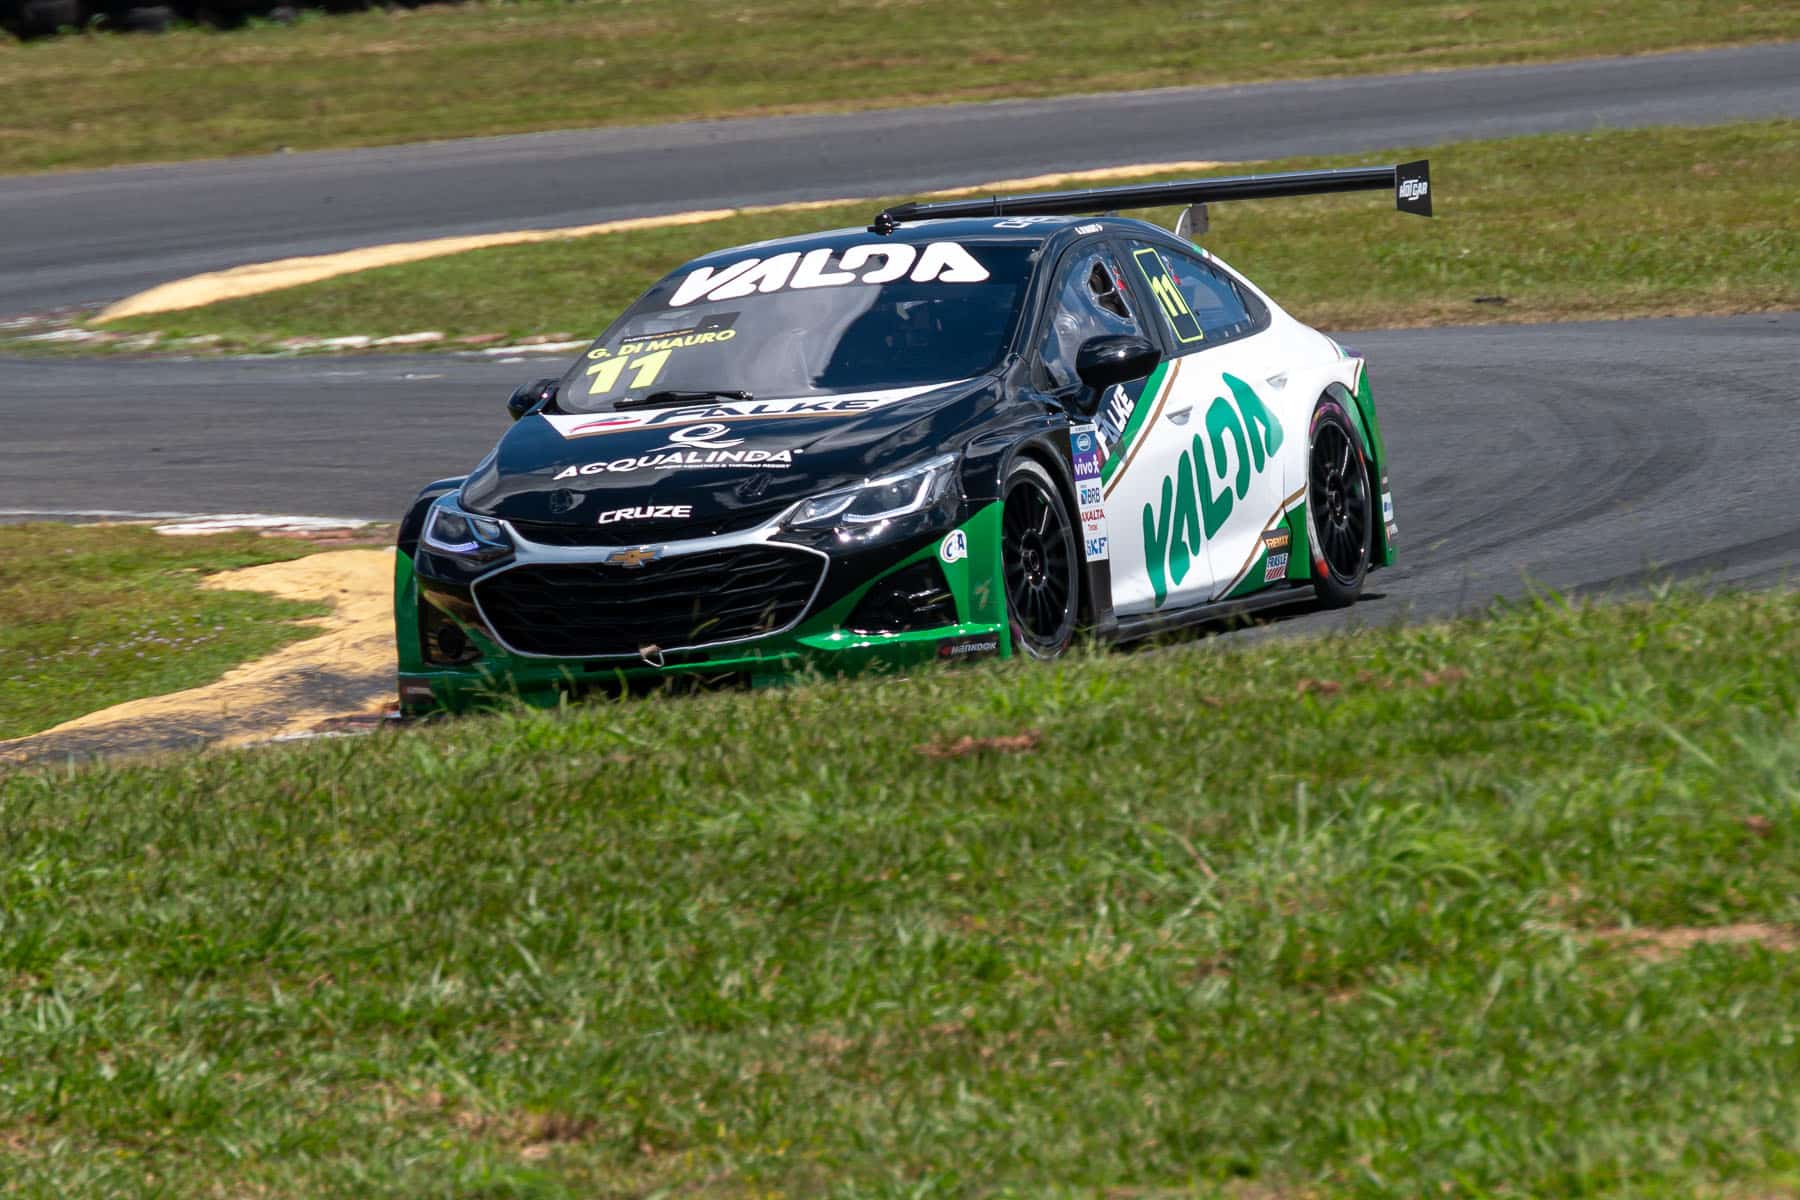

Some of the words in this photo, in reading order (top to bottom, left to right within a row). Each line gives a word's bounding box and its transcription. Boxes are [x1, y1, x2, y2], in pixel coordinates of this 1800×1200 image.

[668, 241, 990, 307] VALDA
[1152, 273, 1188, 317] 11
[587, 348, 611, 359] G.
[617, 344, 645, 356] DI
[645, 329, 736, 351] MAURO
[586, 349, 673, 394] 11
[646, 399, 879, 424] FALKE
[552, 450, 793, 480] ACQUALINDA
[1074, 457, 1093, 475] vivo
[1087, 488, 1101, 504] BRB
[1143, 372, 1284, 608] VALDA
[598, 505, 693, 524] CRUZE
